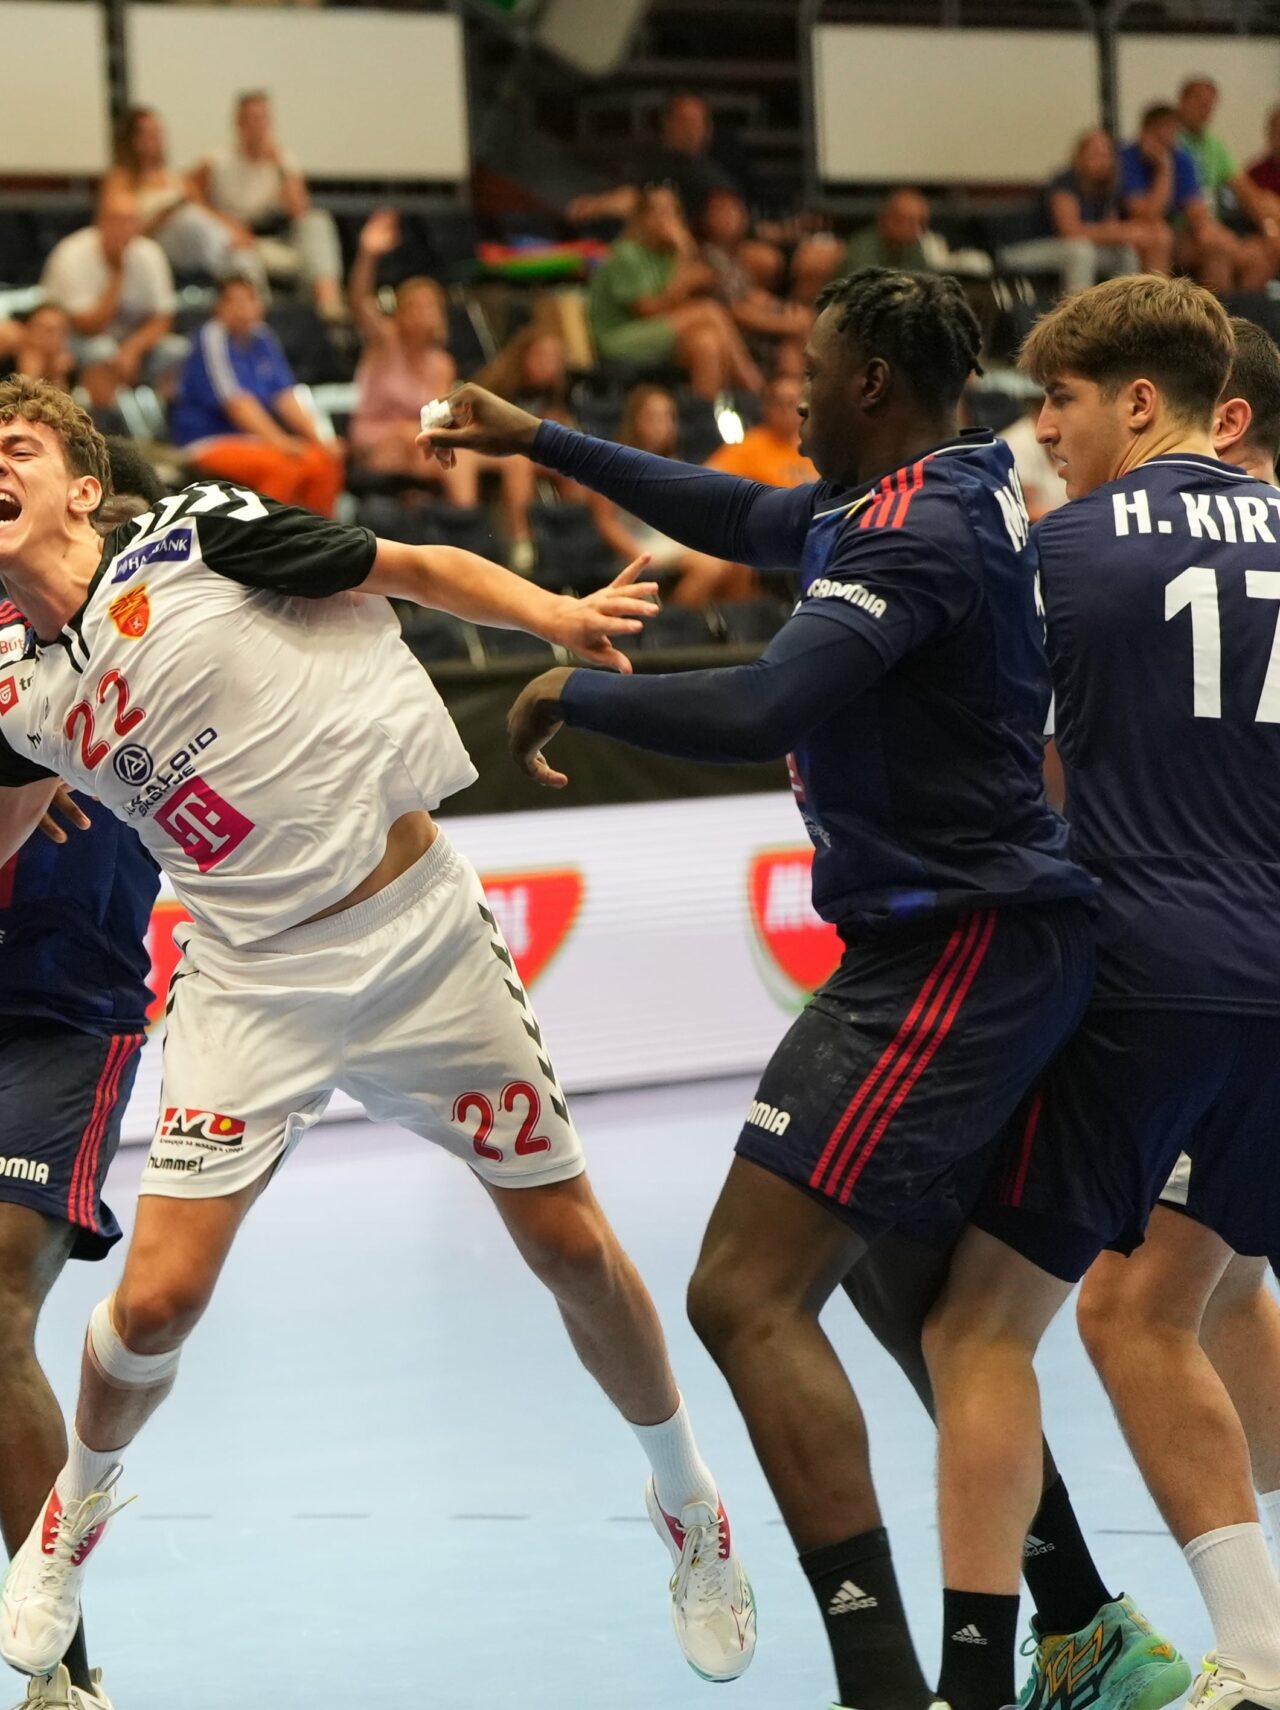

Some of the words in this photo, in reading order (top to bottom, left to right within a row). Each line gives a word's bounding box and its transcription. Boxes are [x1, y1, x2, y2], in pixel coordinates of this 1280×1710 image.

[1112, 489, 1172, 536] H.
[63, 668, 146, 770] 22
[451, 1081, 551, 1162] 22
[149, 1155, 204, 1173] hummel
[827, 1596, 878, 1616] adidas
[951, 1634, 989, 1646] adidas
